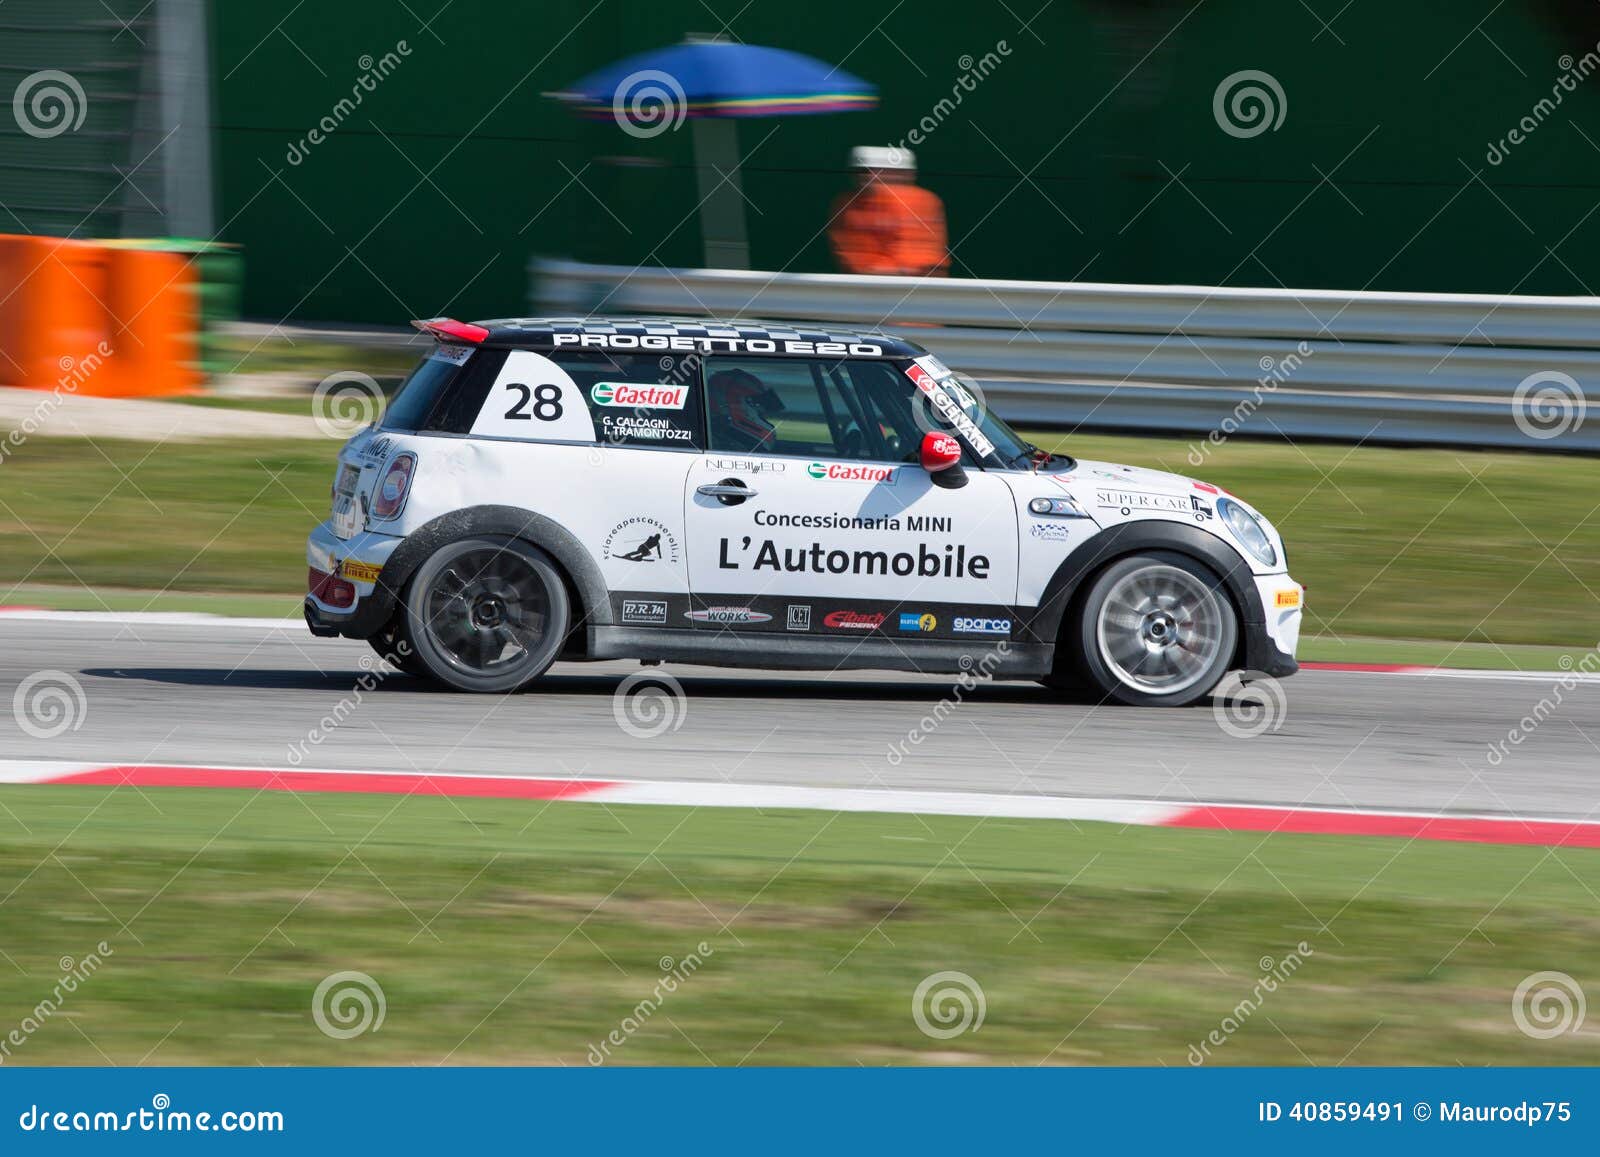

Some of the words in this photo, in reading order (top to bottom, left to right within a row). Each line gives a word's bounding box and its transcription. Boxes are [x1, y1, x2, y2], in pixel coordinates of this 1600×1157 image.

[552, 334, 776, 353] PROGETTO
[785, 341, 883, 357] E20
[503, 383, 563, 422] 28
[614, 385, 681, 406] Castrol
[602, 416, 614, 426] G.
[616, 417, 669, 429] CALCAGNI
[612, 426, 692, 440] TRAMONTOZZI
[828, 464, 893, 482] Castrol
[1096, 493, 1149, 506] SUPER
[1154, 495, 1189, 510] CAR
[754, 510, 900, 531] Concessionaria
[907, 516, 952, 532] MINI
[707, 610, 751, 621] WORKS
[790, 607, 809, 623] ICET
[953, 617, 1011, 632] sparco
